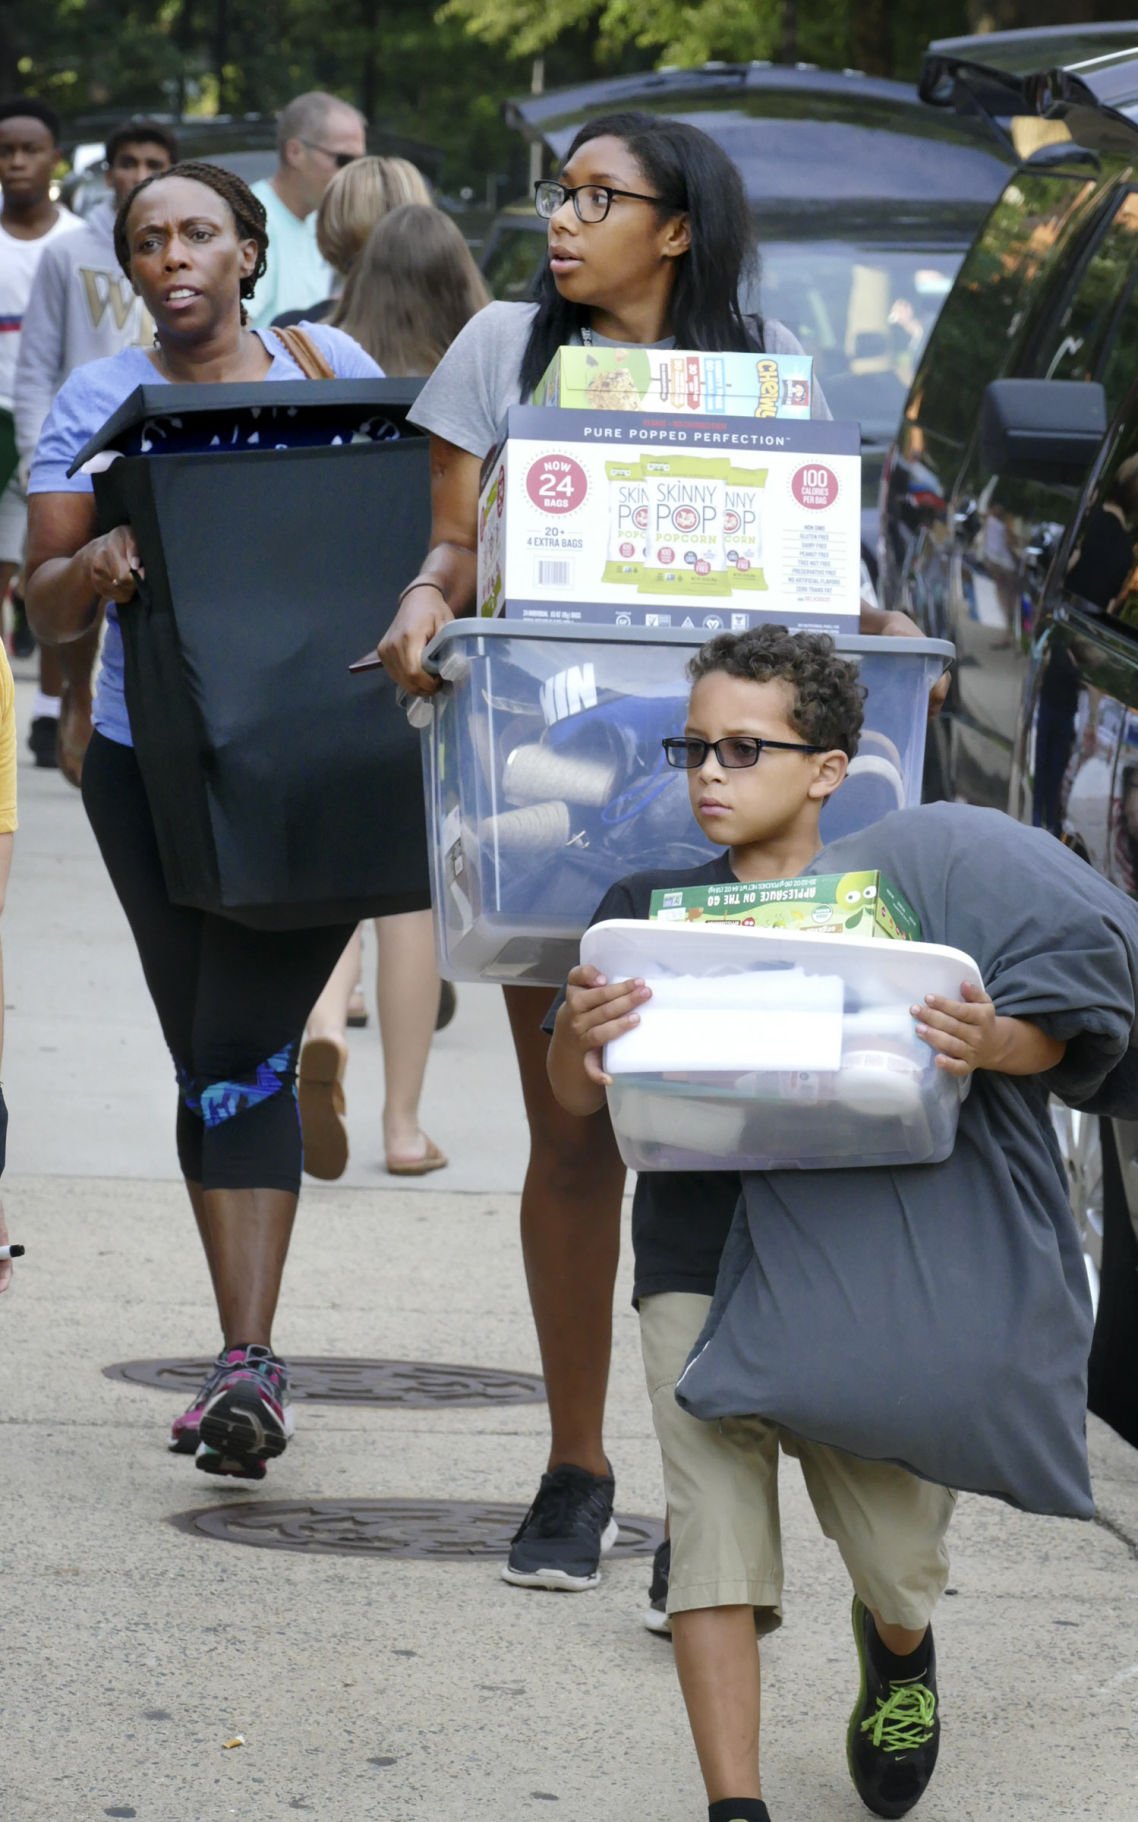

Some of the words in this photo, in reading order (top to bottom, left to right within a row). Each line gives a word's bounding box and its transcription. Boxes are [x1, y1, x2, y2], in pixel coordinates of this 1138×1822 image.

[583, 427, 622, 438] PURE
[629, 429, 687, 441] POPPED
[543, 460, 571, 473] NOW
[803, 469, 828, 487] 100
[538, 473, 574, 497] 24
[544, 498, 569, 508] BAGS
[802, 495, 815, 504] PER
[815, 496, 828, 505] BAG
[657, 503, 718, 534] POP
[527, 537, 533, 546] 4
[534, 537, 560, 547] EXTRA
[561, 538, 583, 549] BAGS
[656, 533, 717, 545] POPCORN
[723, 893, 741, 905] THE
[743, 892, 756, 903] ON
[760, 886, 816, 902] APPLESAUCE
[707, 895, 721, 907] GO
